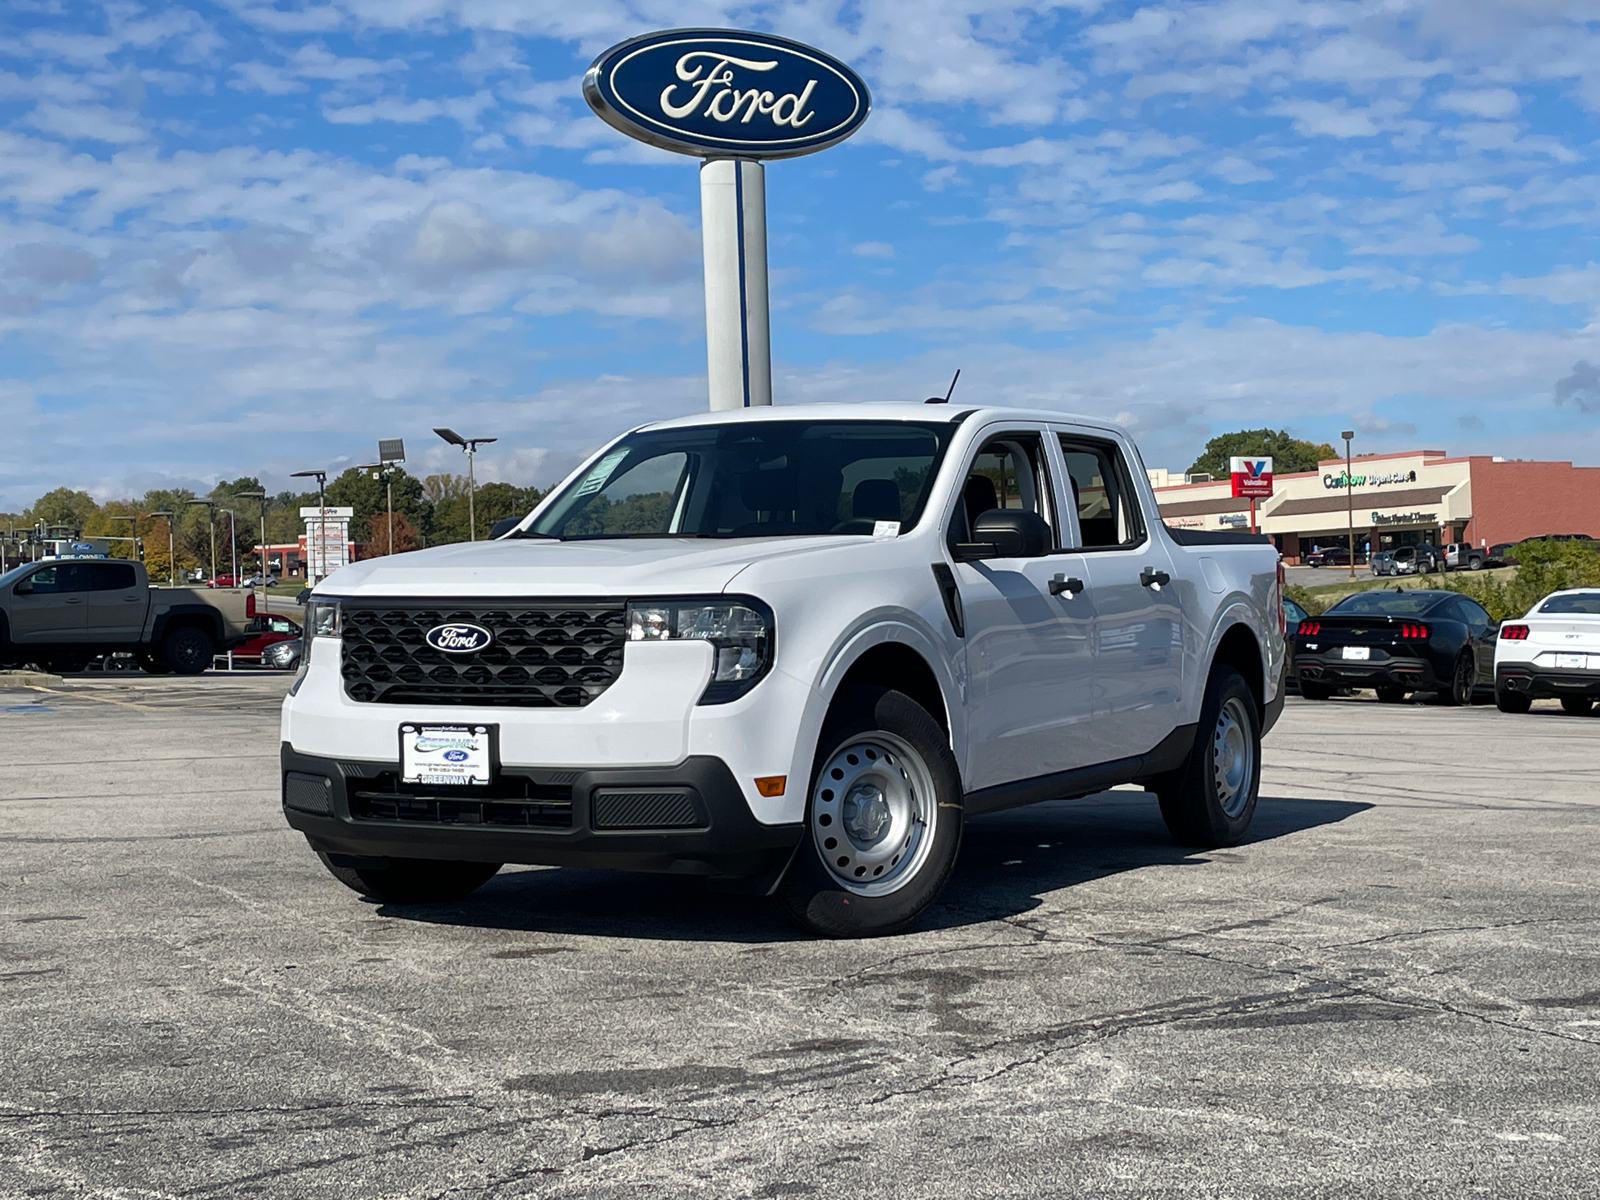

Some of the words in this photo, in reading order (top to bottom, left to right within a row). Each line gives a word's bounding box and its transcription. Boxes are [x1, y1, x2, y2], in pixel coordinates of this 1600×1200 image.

[660, 51, 818, 128] Ford
[1324, 470, 1366, 488] CareNow
[438, 627, 478, 648] Ford
[448, 750, 464, 760] Ford
[421, 774, 469, 785] GREENWAY
